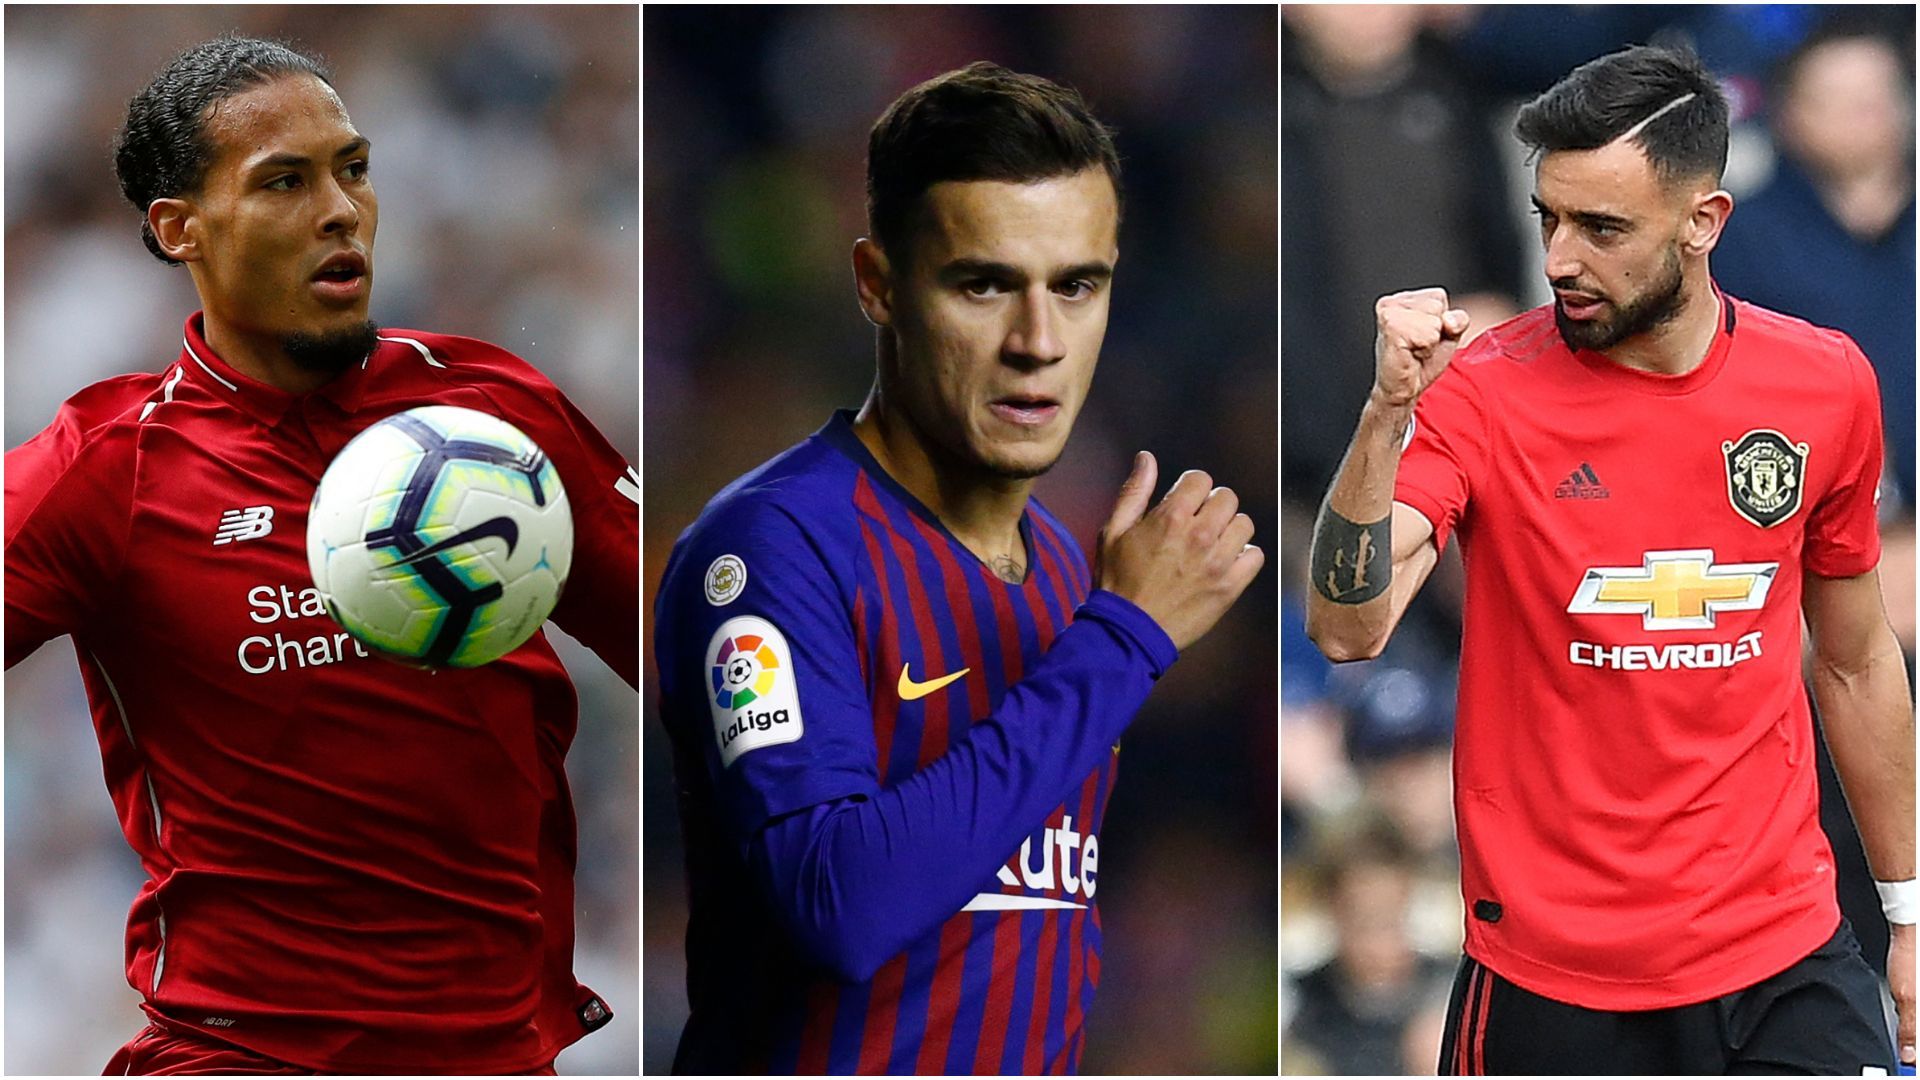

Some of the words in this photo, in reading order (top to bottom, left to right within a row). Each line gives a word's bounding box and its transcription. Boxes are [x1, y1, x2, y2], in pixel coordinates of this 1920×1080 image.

[247, 584, 327, 624] Sta
[1569, 631, 1763, 670] CHEVROLET
[721, 709, 789, 749] LaLiga
